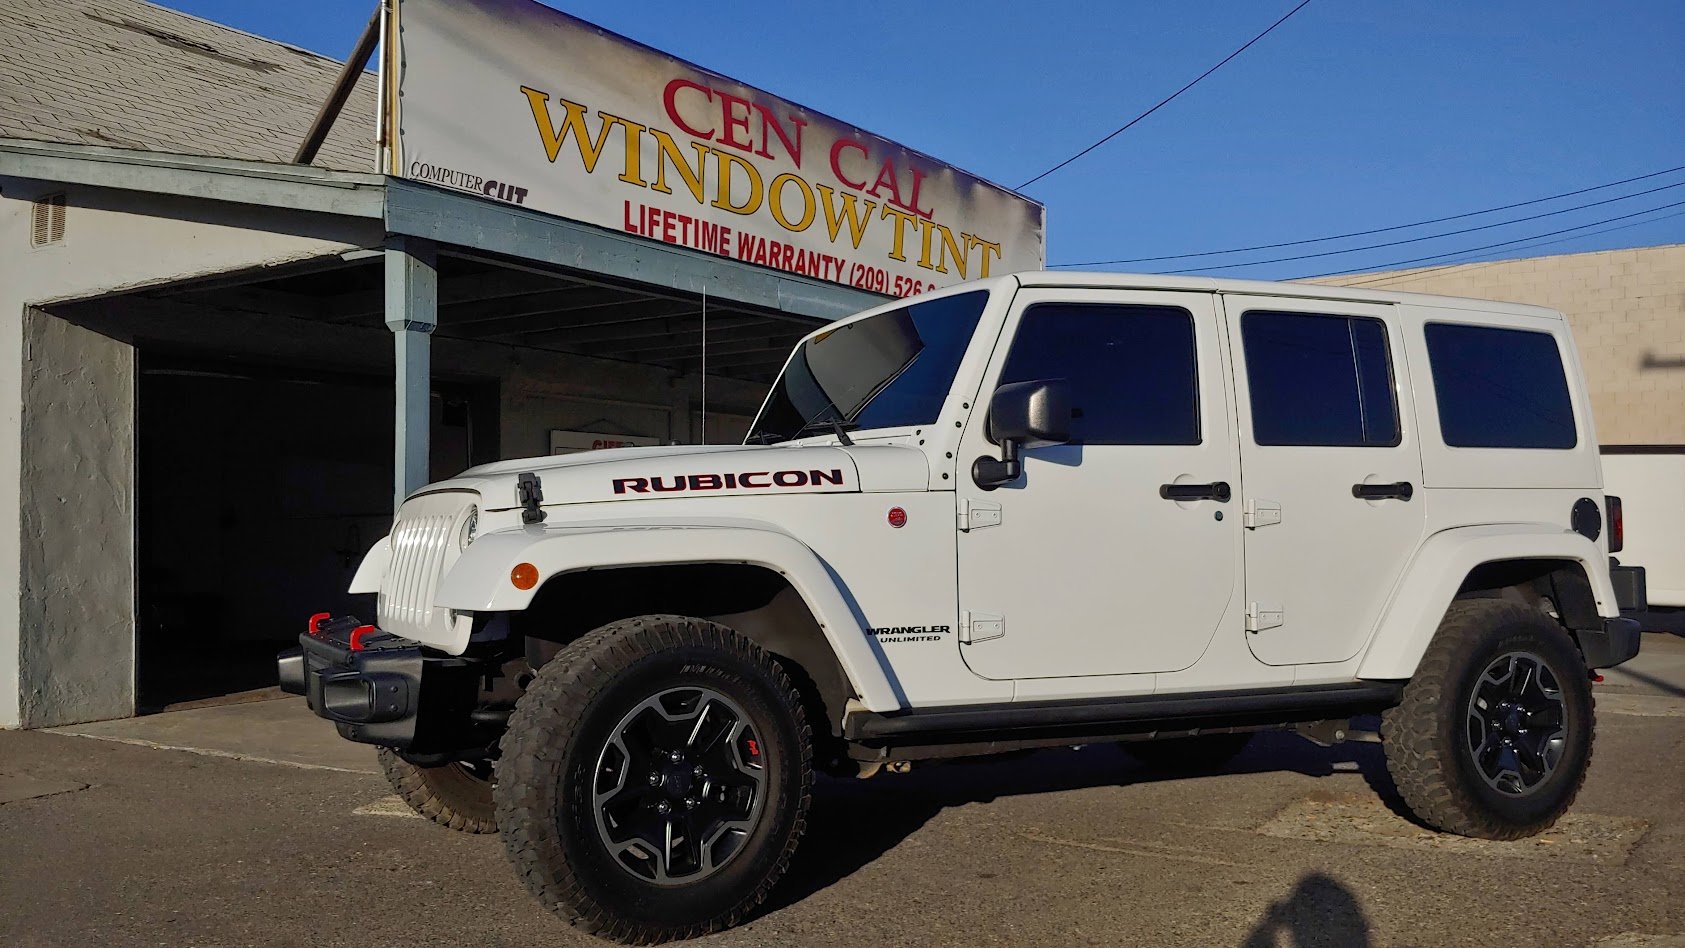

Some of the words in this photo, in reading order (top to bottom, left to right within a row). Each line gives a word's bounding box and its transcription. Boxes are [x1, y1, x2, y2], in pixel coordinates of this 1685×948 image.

[663, 78, 808, 170] CEN
[829, 138, 934, 220] CAL
[624, 199, 731, 258] LIFETIME
[737, 231, 846, 284] WARRANTY
[849, 262, 890, 294] (209)
[612, 469, 844, 495] RUBICON
[866, 625, 951, 636] WRANGLER
[880, 635, 941, 643] UNLIMITED
